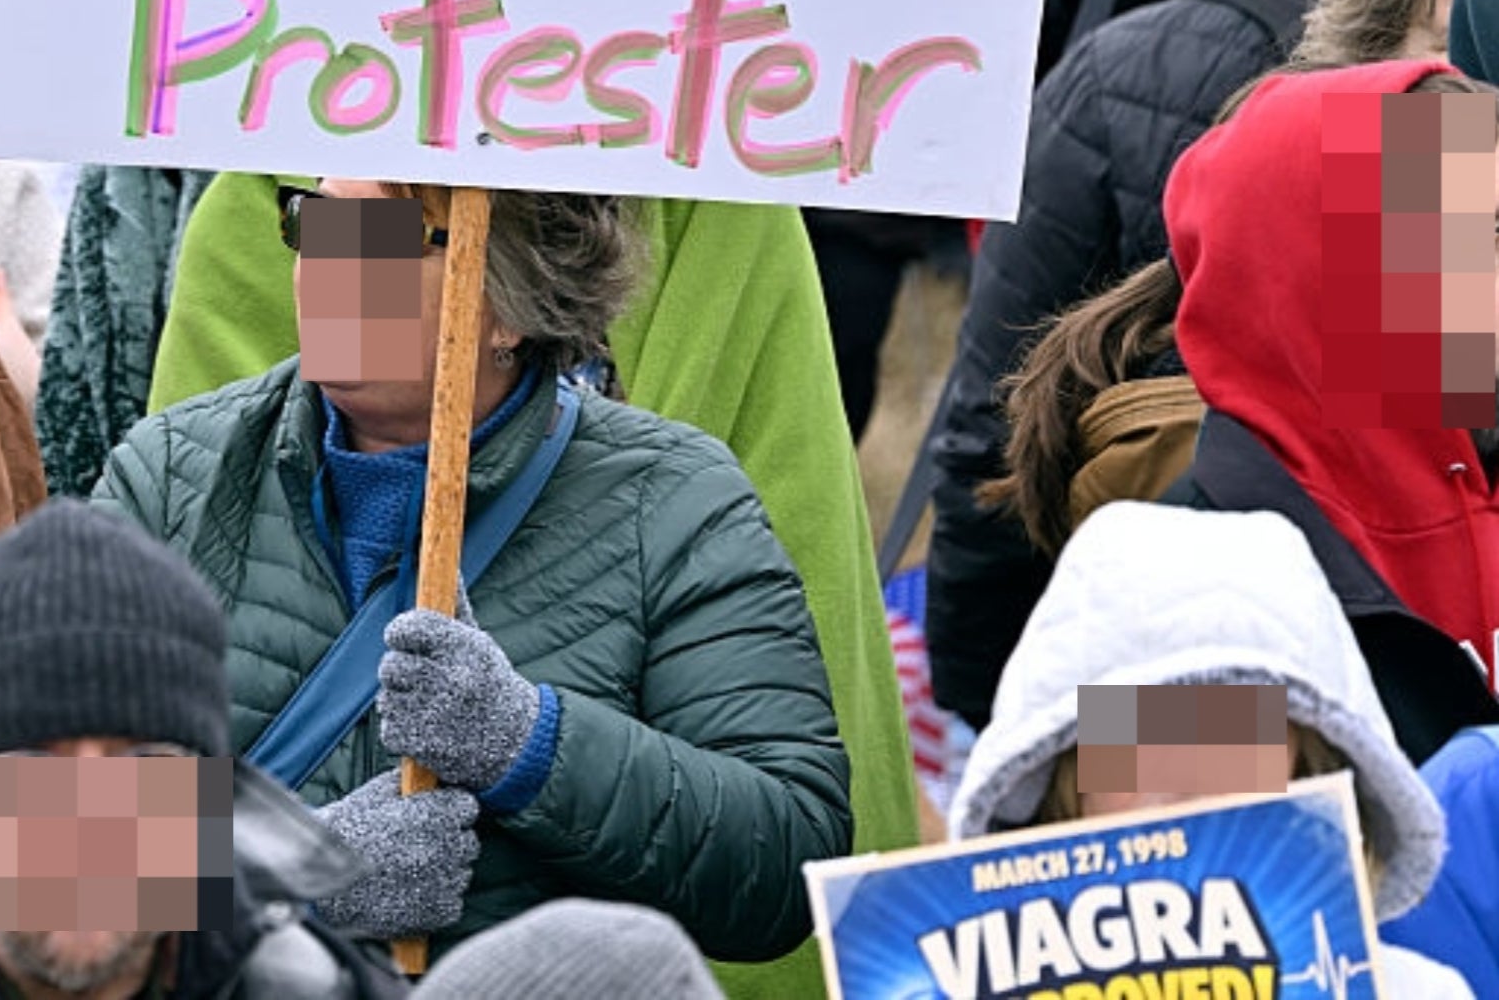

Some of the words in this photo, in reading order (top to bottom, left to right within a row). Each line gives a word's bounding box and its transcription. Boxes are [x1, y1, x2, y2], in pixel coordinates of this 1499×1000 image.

[972, 850, 1069, 893] MARCH
[1073, 842, 1117, 875] 27,
[1118, 828, 1188, 866] 1998
[917, 878, 1268, 1000] VIAGRA
